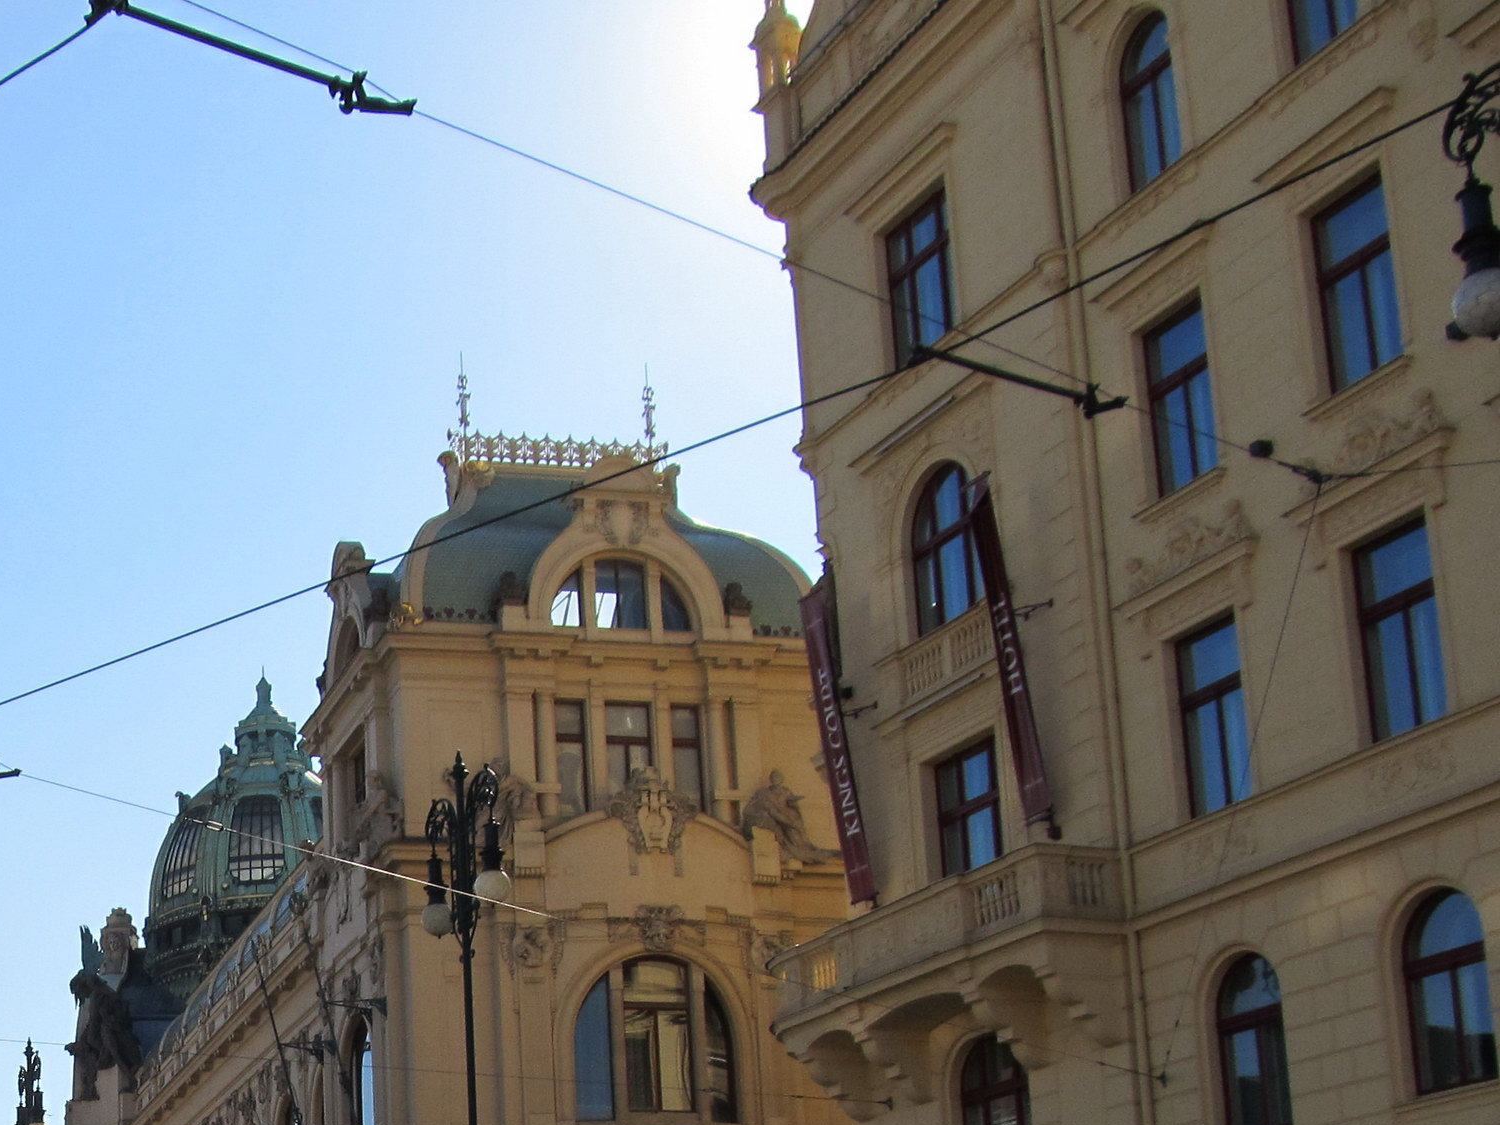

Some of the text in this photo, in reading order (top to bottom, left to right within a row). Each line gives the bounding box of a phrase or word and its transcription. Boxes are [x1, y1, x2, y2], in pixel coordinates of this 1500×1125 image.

[994, 592, 1023, 697] HOTEL
[818, 667, 860, 838] KINGS COURT
